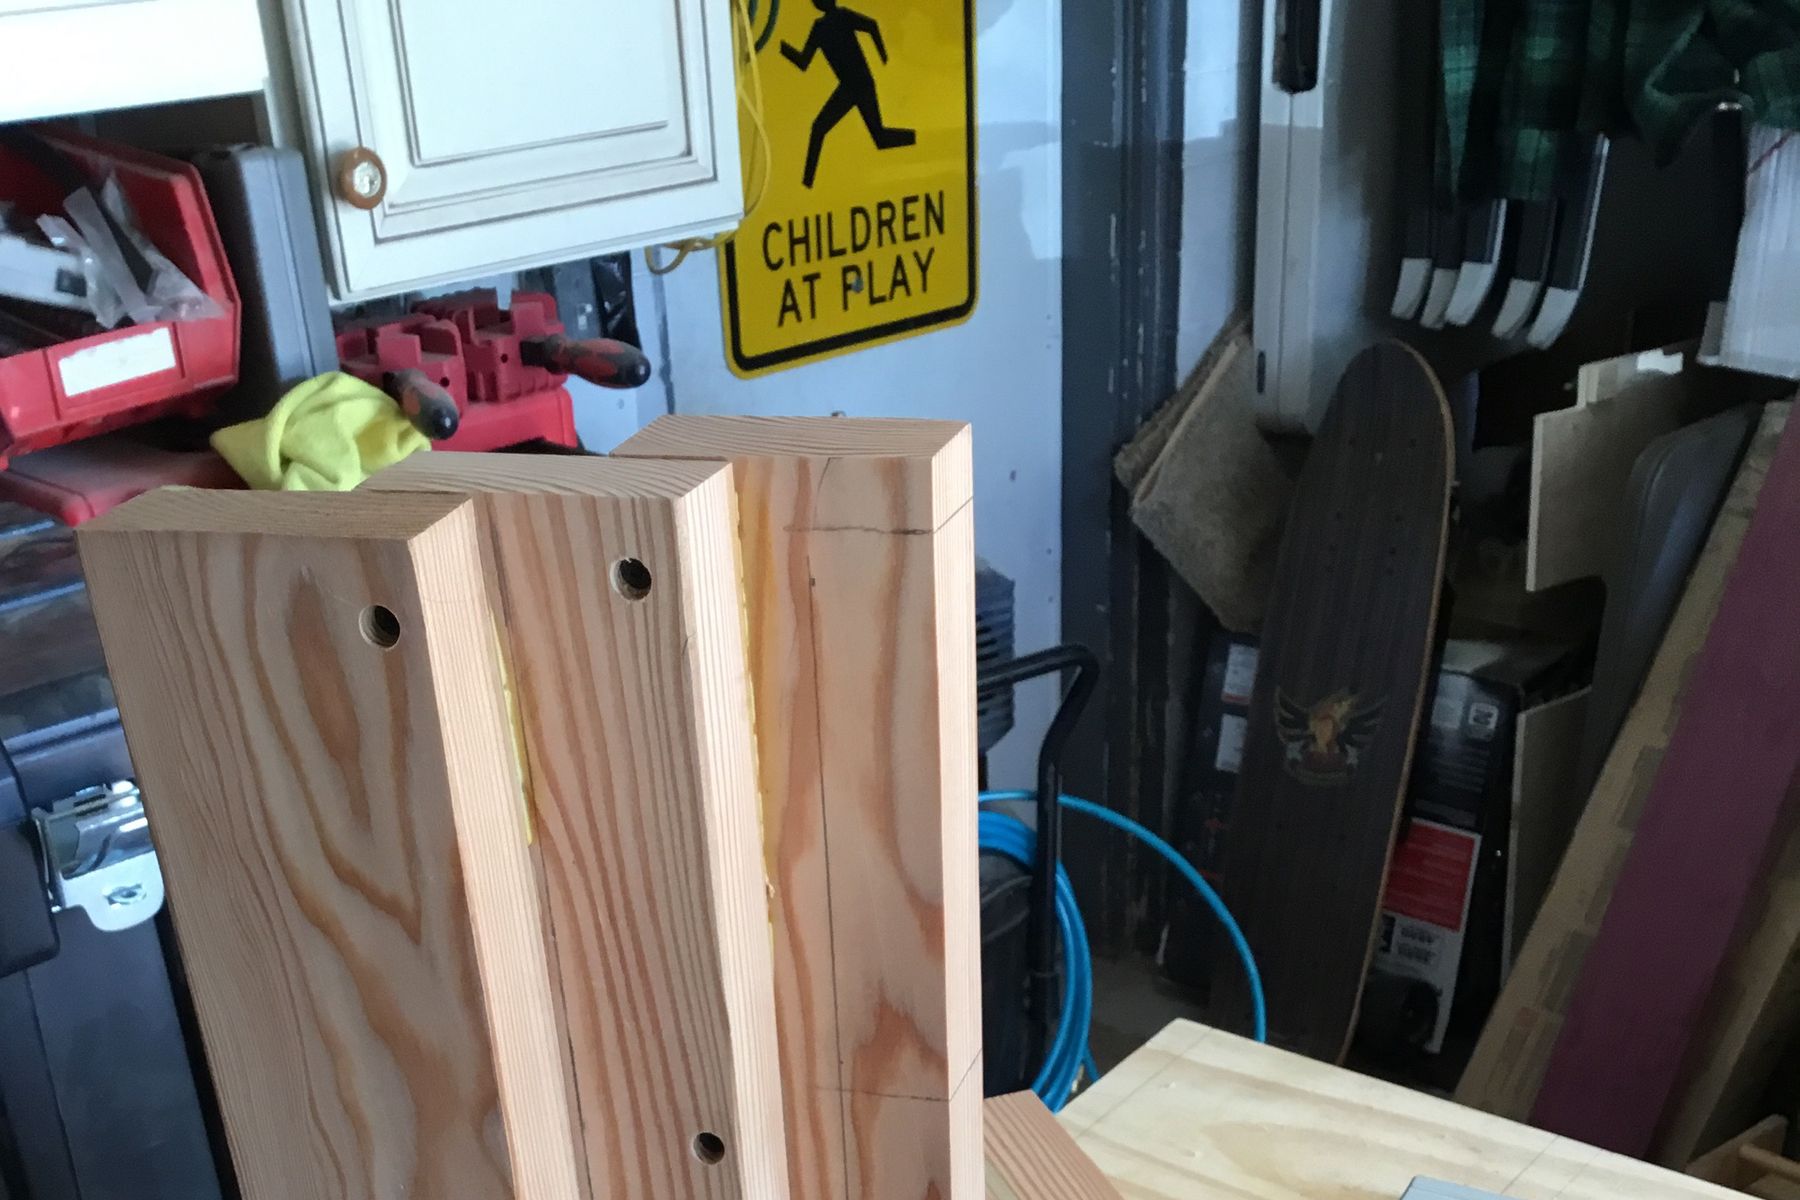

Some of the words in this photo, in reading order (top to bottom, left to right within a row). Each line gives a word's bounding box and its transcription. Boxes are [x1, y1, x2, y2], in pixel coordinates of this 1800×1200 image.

[762, 190, 945, 272] CHILDREN
[778, 273, 821, 328] AT
[841, 247, 935, 312] PLAY
